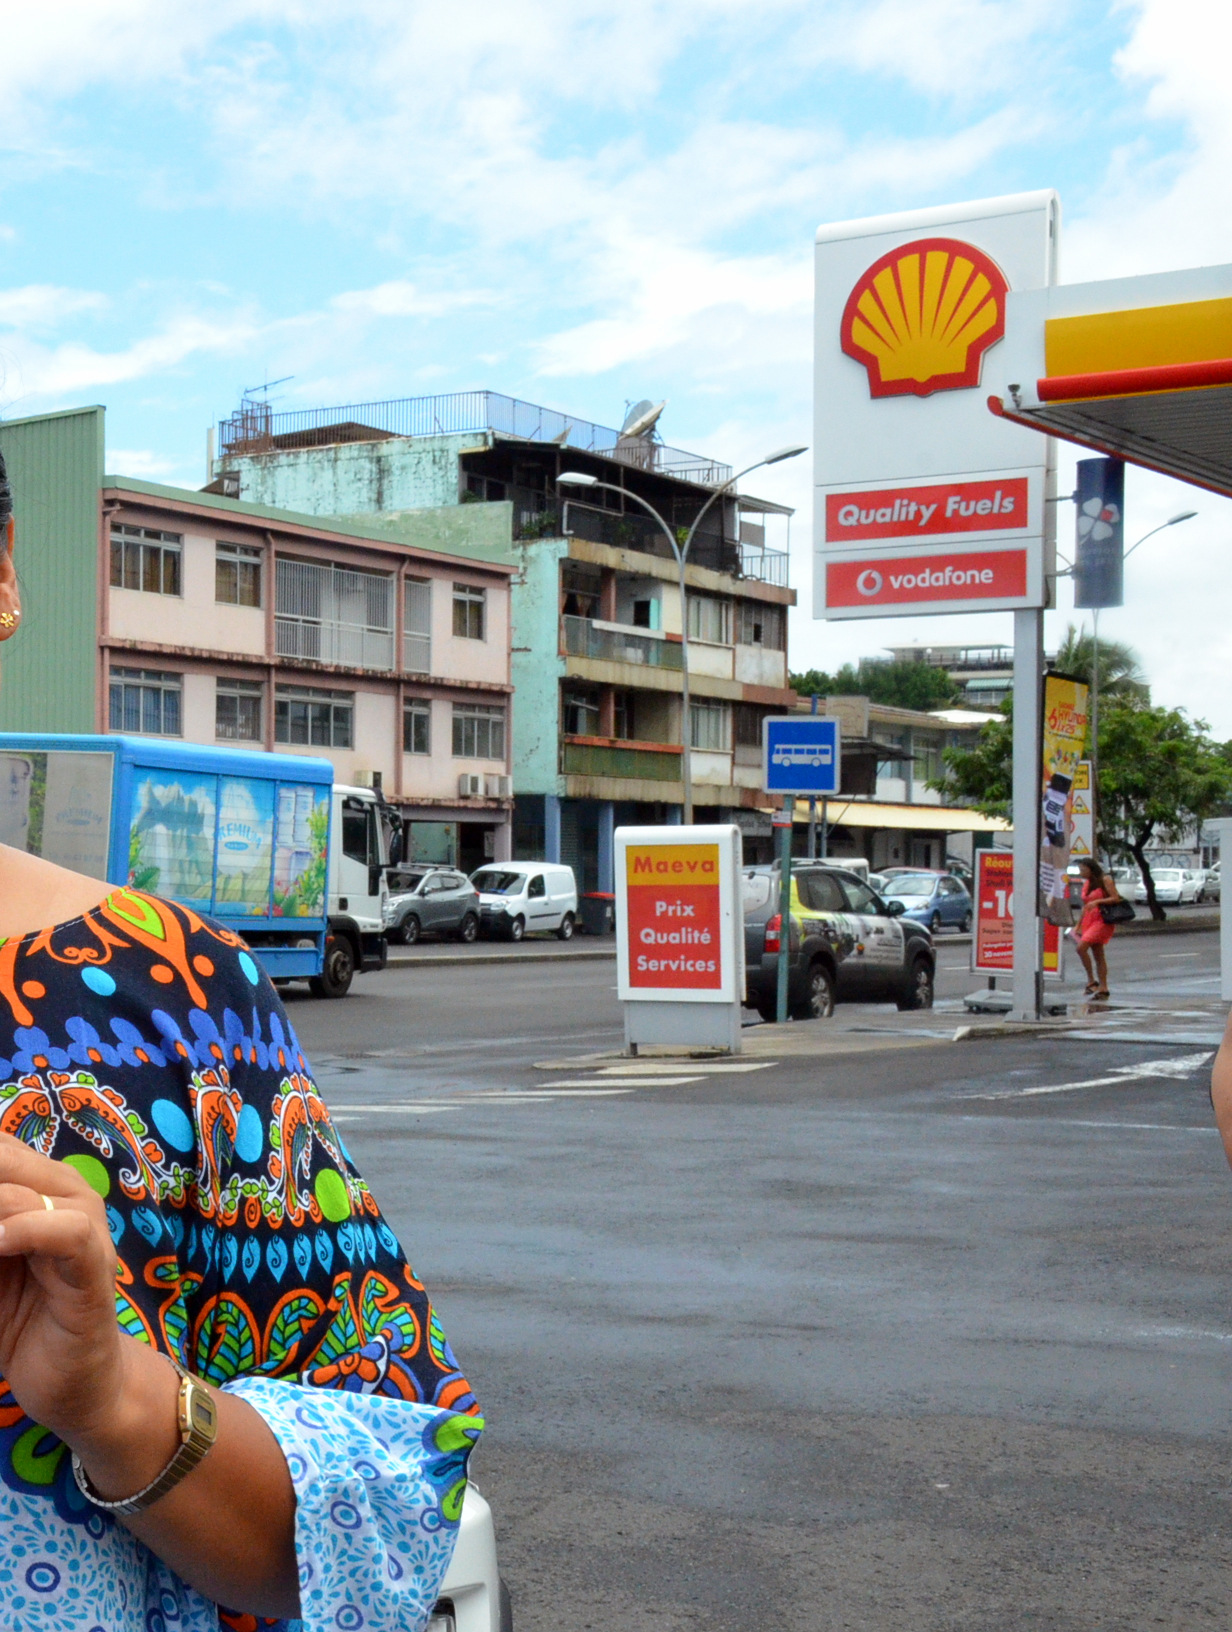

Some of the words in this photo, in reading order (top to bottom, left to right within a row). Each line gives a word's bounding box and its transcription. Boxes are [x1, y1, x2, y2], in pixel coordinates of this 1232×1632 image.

[837, 498, 938, 526] Quality
[945, 490, 1015, 518] Fuels
[889, 566, 994, 589] vodafone
[633, 856, 715, 874] Maeva
[655, 900, 695, 917] Prix
[639, 927, 712, 944] Qualité
[636, 955, 716, 972] Services
